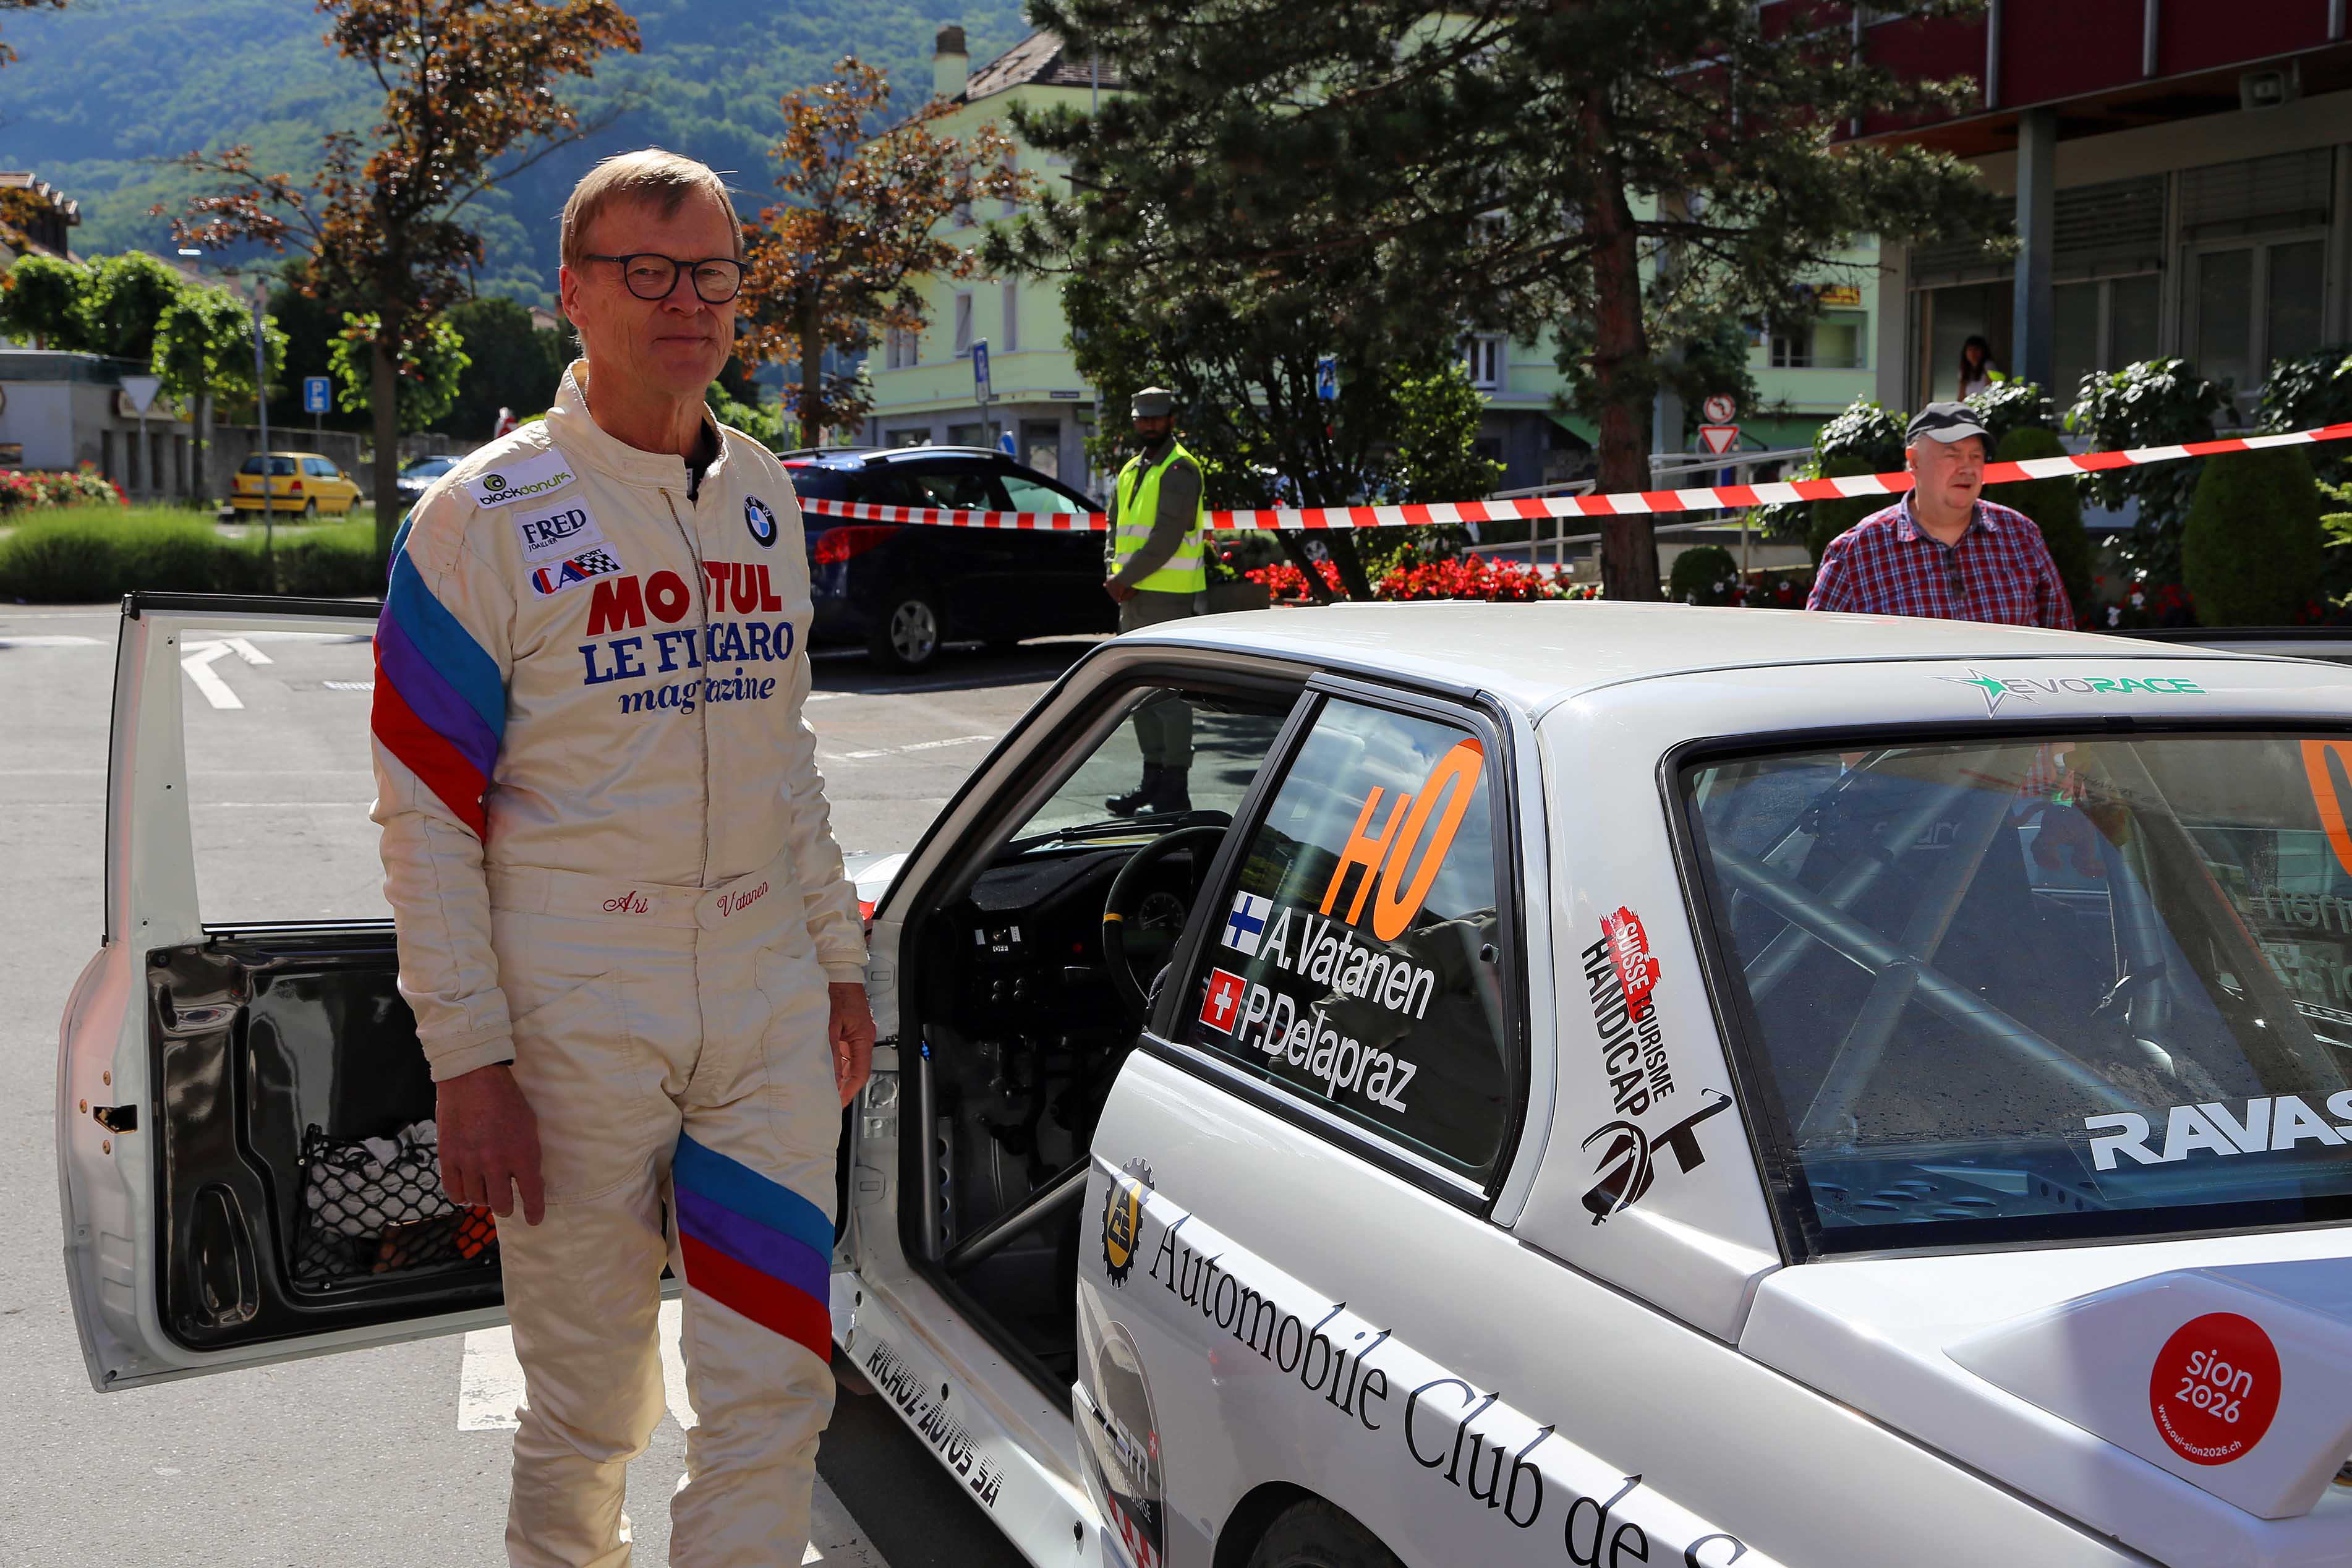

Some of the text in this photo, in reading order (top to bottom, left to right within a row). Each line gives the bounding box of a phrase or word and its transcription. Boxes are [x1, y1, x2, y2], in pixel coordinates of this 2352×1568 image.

[479, 472, 571, 505] blackdonuts
[745, 497, 771, 517] BMW
[522, 509, 587, 544] FRED
[529, 538, 558, 552] JOAILLIER
[574, 548, 603, 562] SPORT
[586, 560, 782, 636] MOTUL
[578, 621, 795, 685] LE FIGARO
[618, 667, 776, 715] magazine
[2001, 678, 2207, 694] EVORACE
[603, 890, 648, 914] Ari
[717, 881, 769, 917] Vatanen
[1260, 906, 1434, 1019] A.Vatanen
[1582, 934, 1650, 1117] HANDICAP
[1616, 922, 1676, 1104] SUISSE TOURISME
[1238, 983, 1417, 1113] P.Delapraz
[1149, 1212, 1649, 1568] Automobile Club de
[2186, 1349, 2253, 1399] sion
[2175, 1376, 2241, 1423] 2026
[2158, 1404, 2243, 1457] www.oui-sion2026.ch
[969, 1453, 1007, 1509] SA
